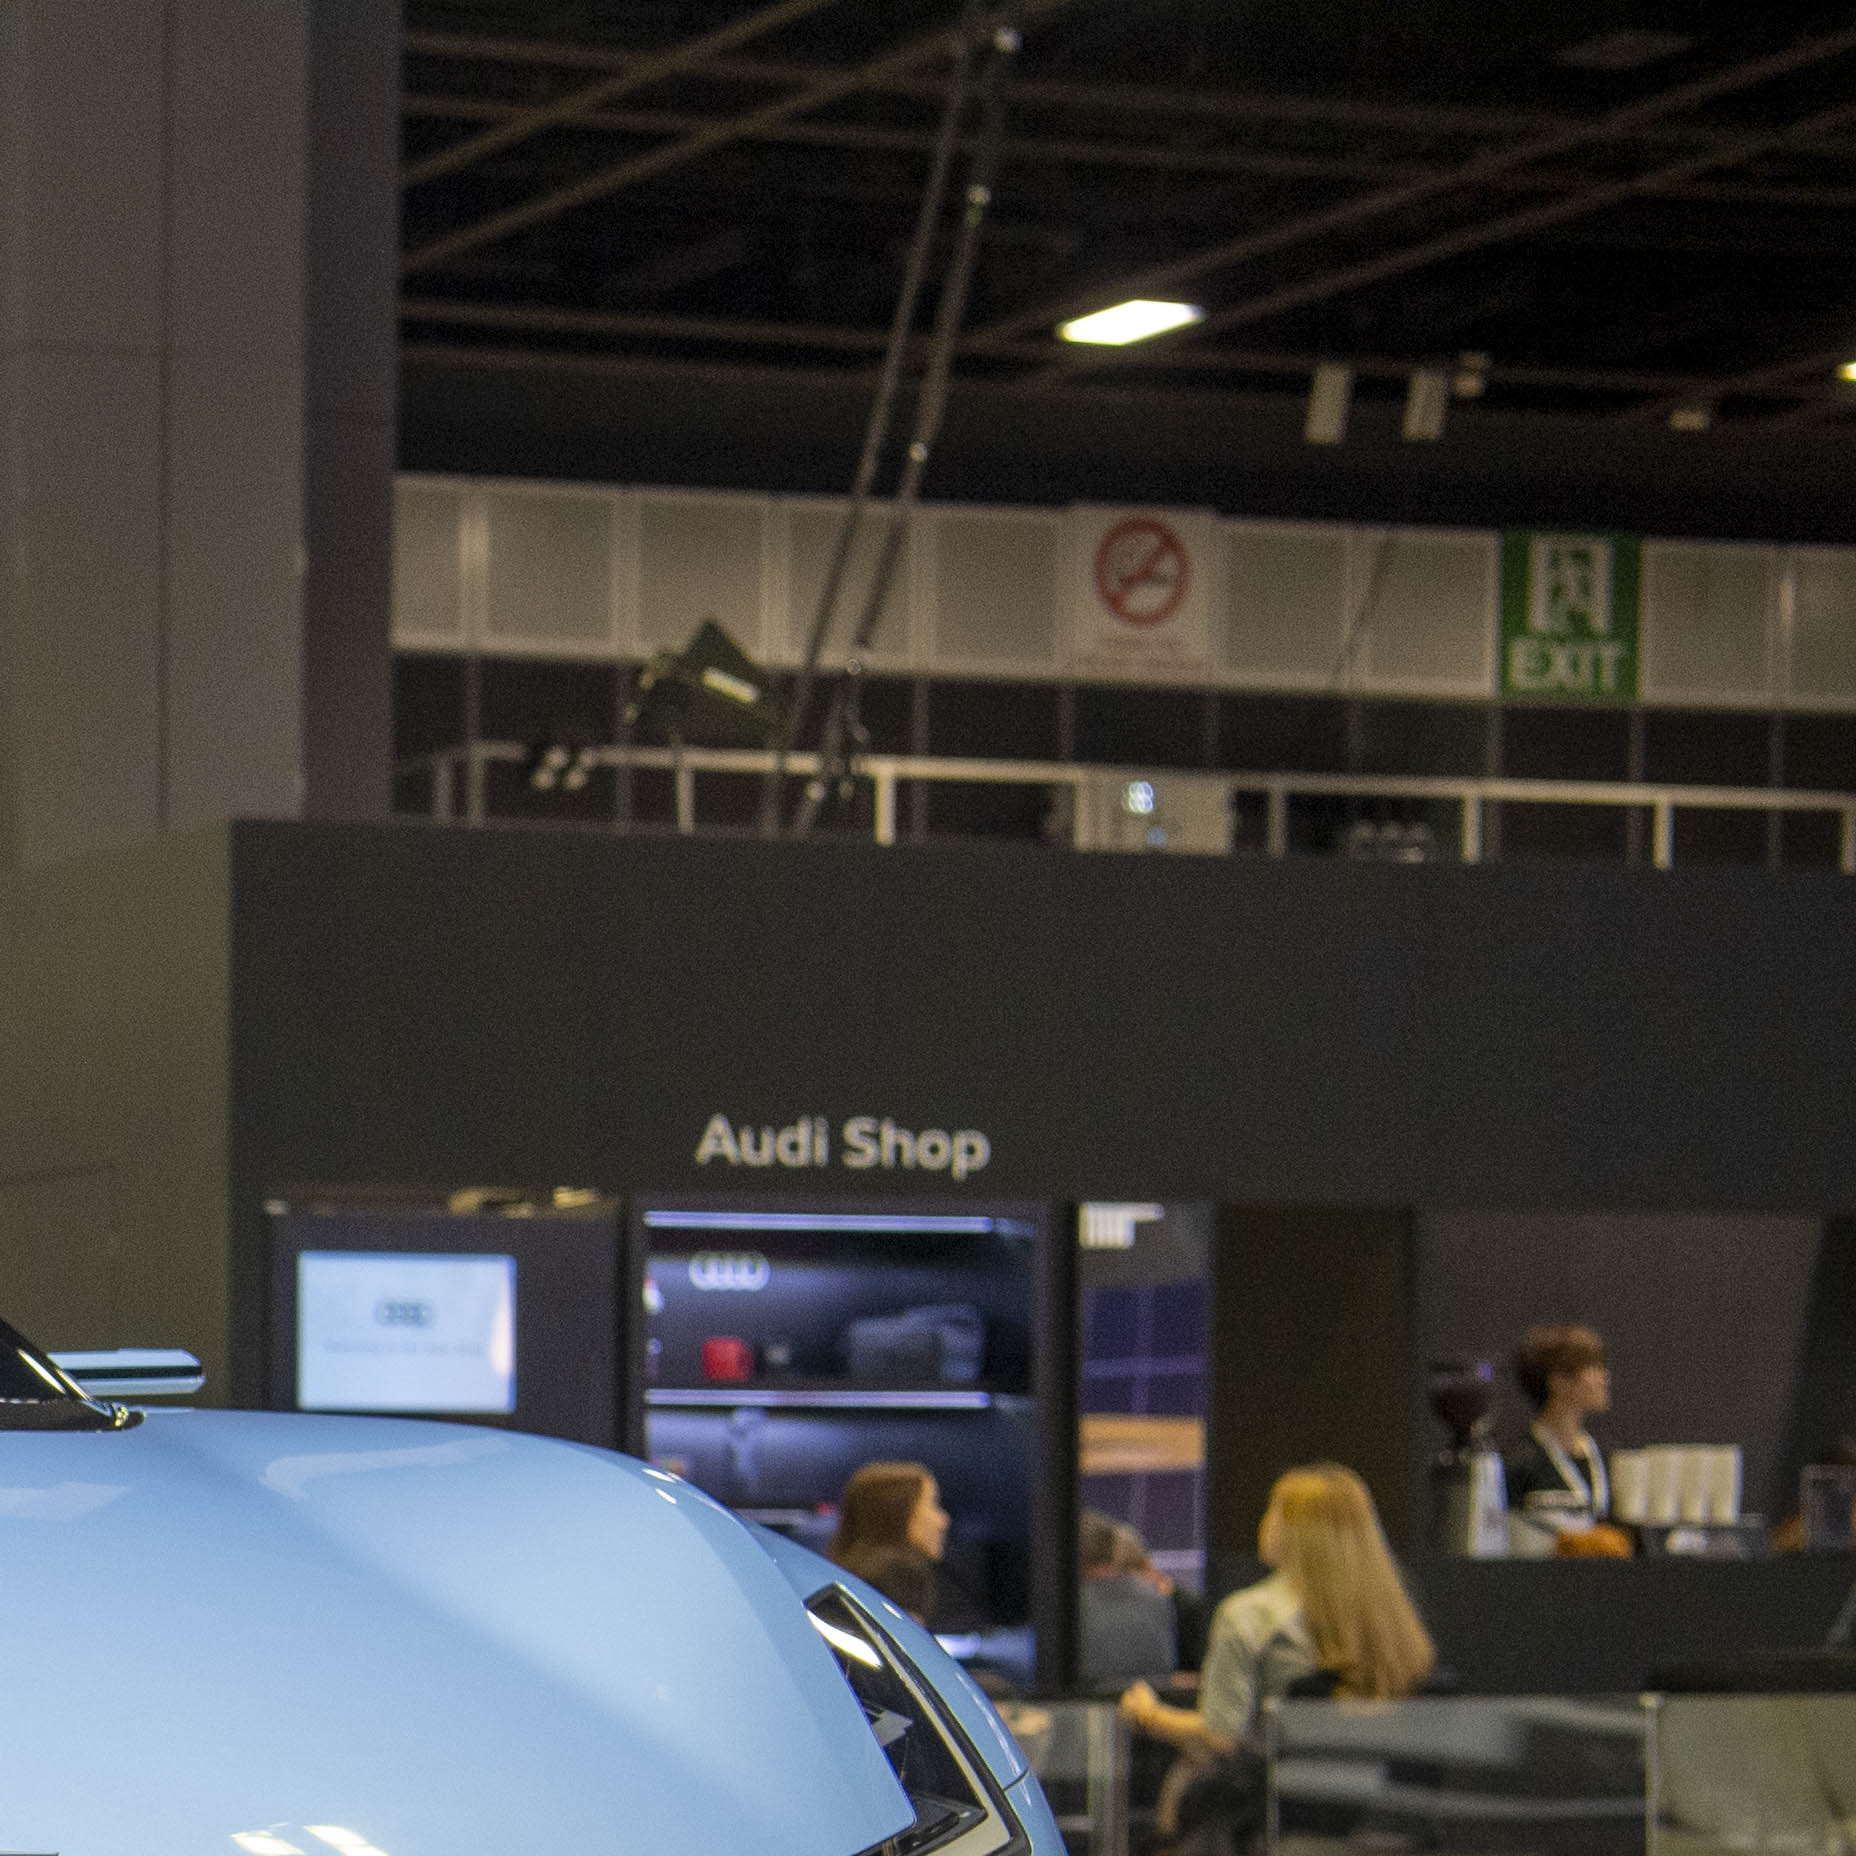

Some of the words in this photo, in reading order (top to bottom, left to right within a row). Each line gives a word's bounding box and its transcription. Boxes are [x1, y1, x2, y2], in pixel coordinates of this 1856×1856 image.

[1508, 641, 1622, 692] EXIT
[695, 1113, 831, 1167] Audi
[842, 1115, 992, 1181] Shop
